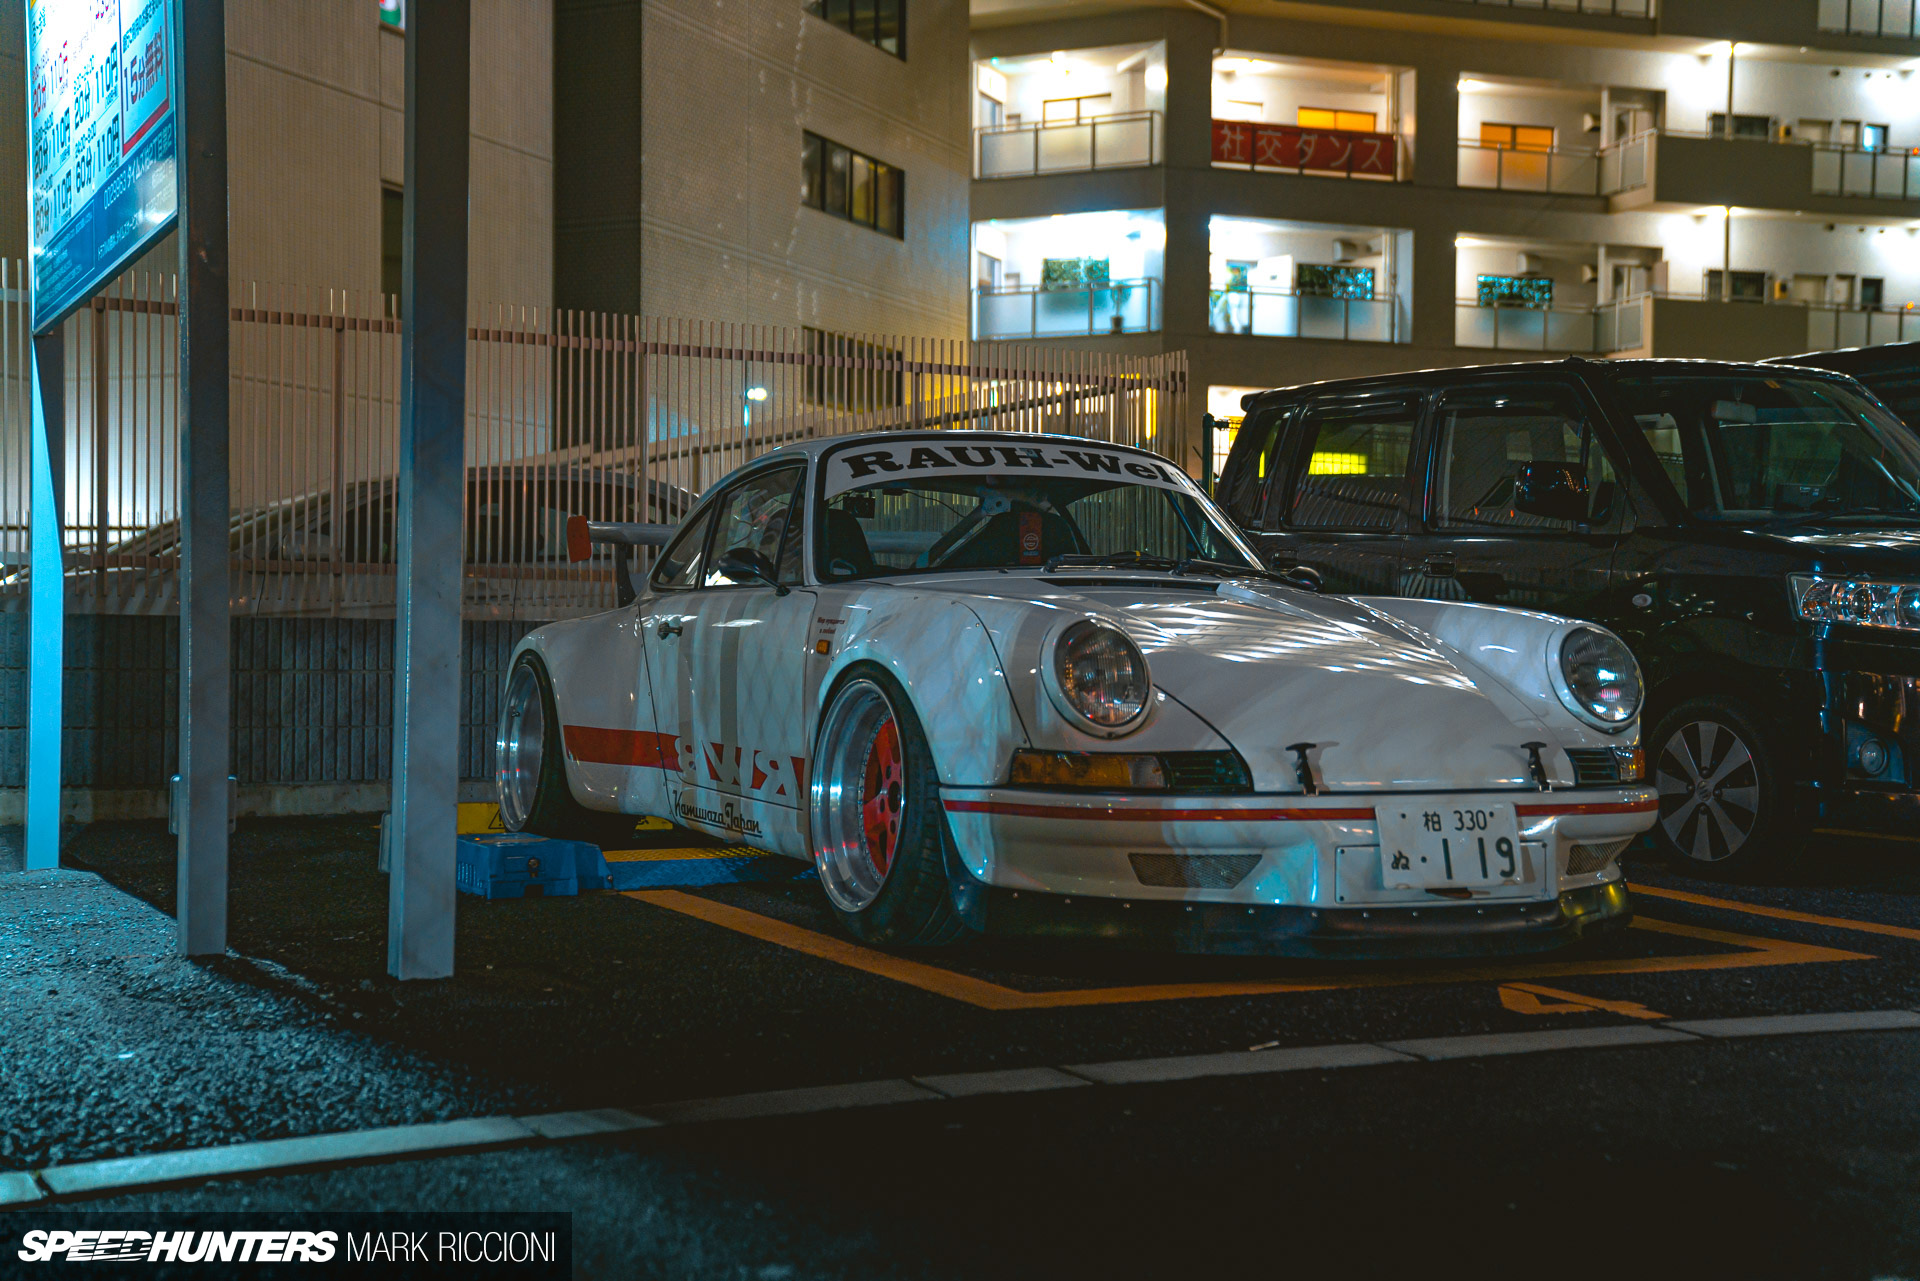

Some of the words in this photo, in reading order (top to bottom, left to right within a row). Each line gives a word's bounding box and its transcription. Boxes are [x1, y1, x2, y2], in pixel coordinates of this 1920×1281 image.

[124, 25, 163, 112] 15分無料
[1220, 124, 1383, 170] 社交ダンス
[841, 446, 1188, 491] RAUH-Wel
[725, 802, 762, 835] Japan
[1422, 810, 1442, 832] 柏
[1453, 809, 1488, 831] 330
[1391, 850, 1411, 870] ぬ
